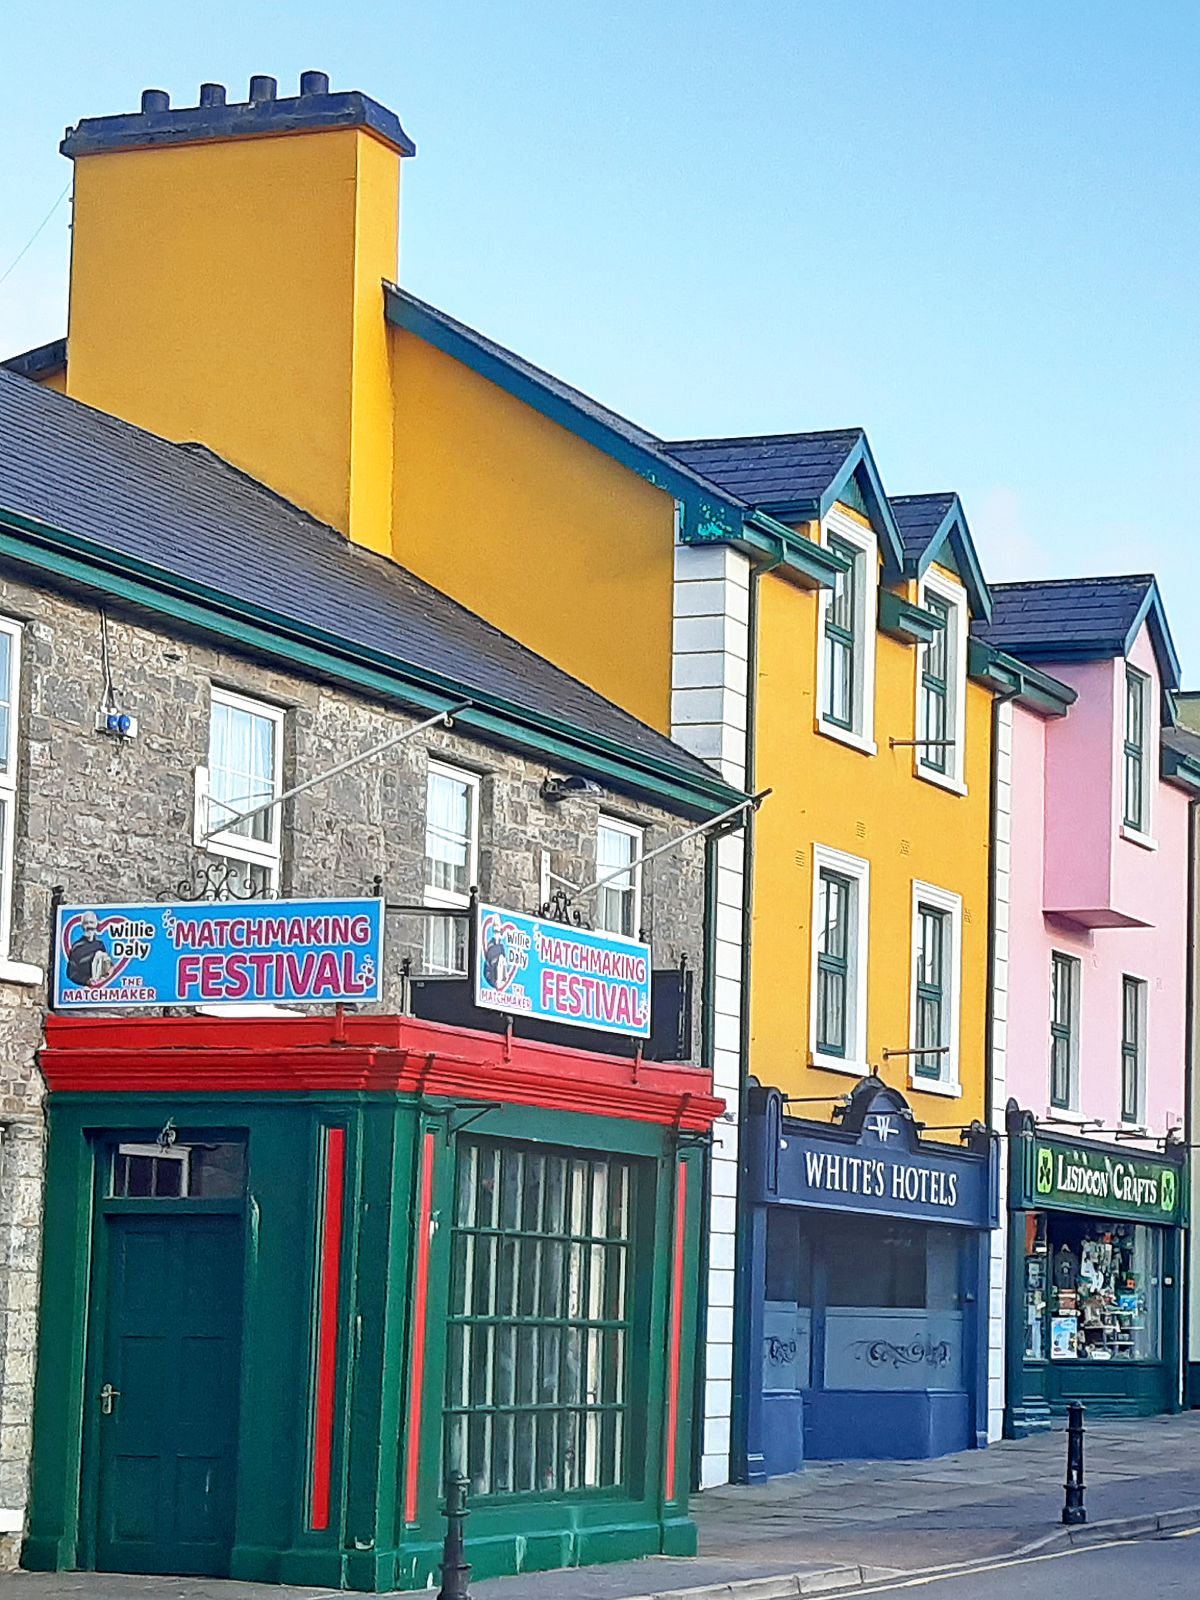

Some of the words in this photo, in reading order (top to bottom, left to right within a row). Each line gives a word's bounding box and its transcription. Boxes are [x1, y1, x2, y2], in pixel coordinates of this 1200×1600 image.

[110, 922, 153, 938] Willie
[175, 916, 370, 948] MATCHMAKING
[507, 931, 530, 949] Willie
[114, 942, 149, 959] Daly
[509, 949, 528, 969] Daly
[540, 937, 646, 983] MATCHMAKING
[122, 977, 142, 986] THE
[177, 953, 365, 998] FESTIVAL
[63, 988, 156, 1001] MATCHMAKER
[542, 971, 644, 1026] FESTIVAL
[805, 1151, 885, 1197] WHITE'S
[892, 1164, 957, 1207] HOTELS
